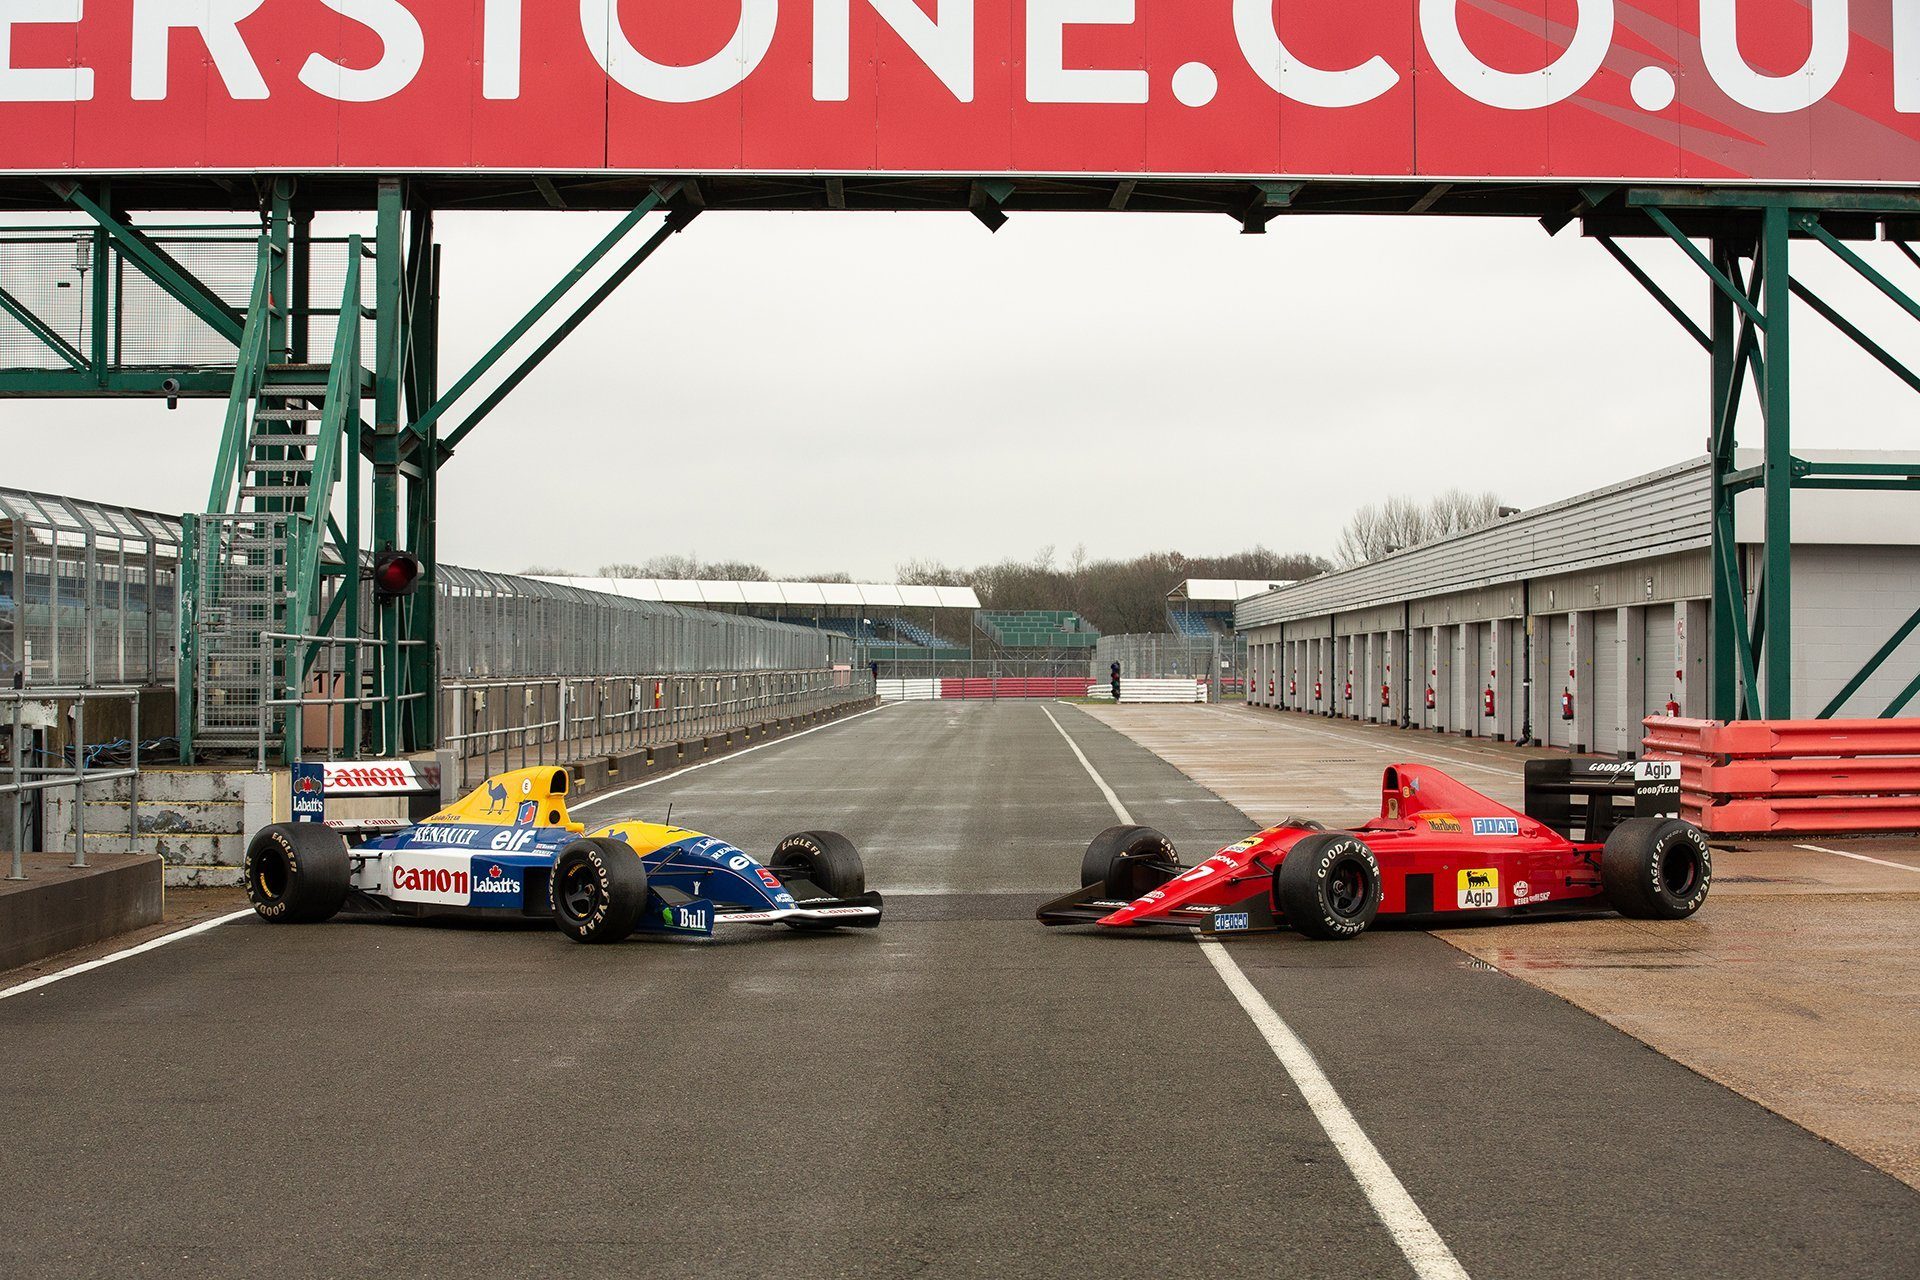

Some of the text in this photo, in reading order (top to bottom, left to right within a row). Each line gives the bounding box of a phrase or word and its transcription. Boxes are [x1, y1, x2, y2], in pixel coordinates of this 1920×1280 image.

[0, 0, 1920, 113] ERSONE.CO.U
[313, 672, 341, 693] 17
[1589, 762, 1636, 773] GOODY
[1645, 761, 1672, 779] Agip
[1637, 784, 1679, 796] GOODYEAR
[293, 796, 323, 812] Labatt's
[1429, 817, 1461, 832] Marlboro
[1474, 819, 1516, 832] FIAT
[411, 826, 479, 845] RENAULT
[491, 829, 537, 851] elf
[781, 837, 812, 851] EAGLE
[1317, 841, 1380, 878] GOODYEAR
[755, 868, 782, 888] 5
[1651, 851, 1662, 893] EAGLE
[1687, 829, 1711, 910] GOODYEAR
[393, 865, 468, 894] Canon
[473, 876, 520, 893] Labatt's
[579, 850, 610, 936] GOODYEAR
[1465, 890, 1493, 906] Agip
[680, 908, 706, 929] Bull
[1215, 914, 1247, 929] digital
